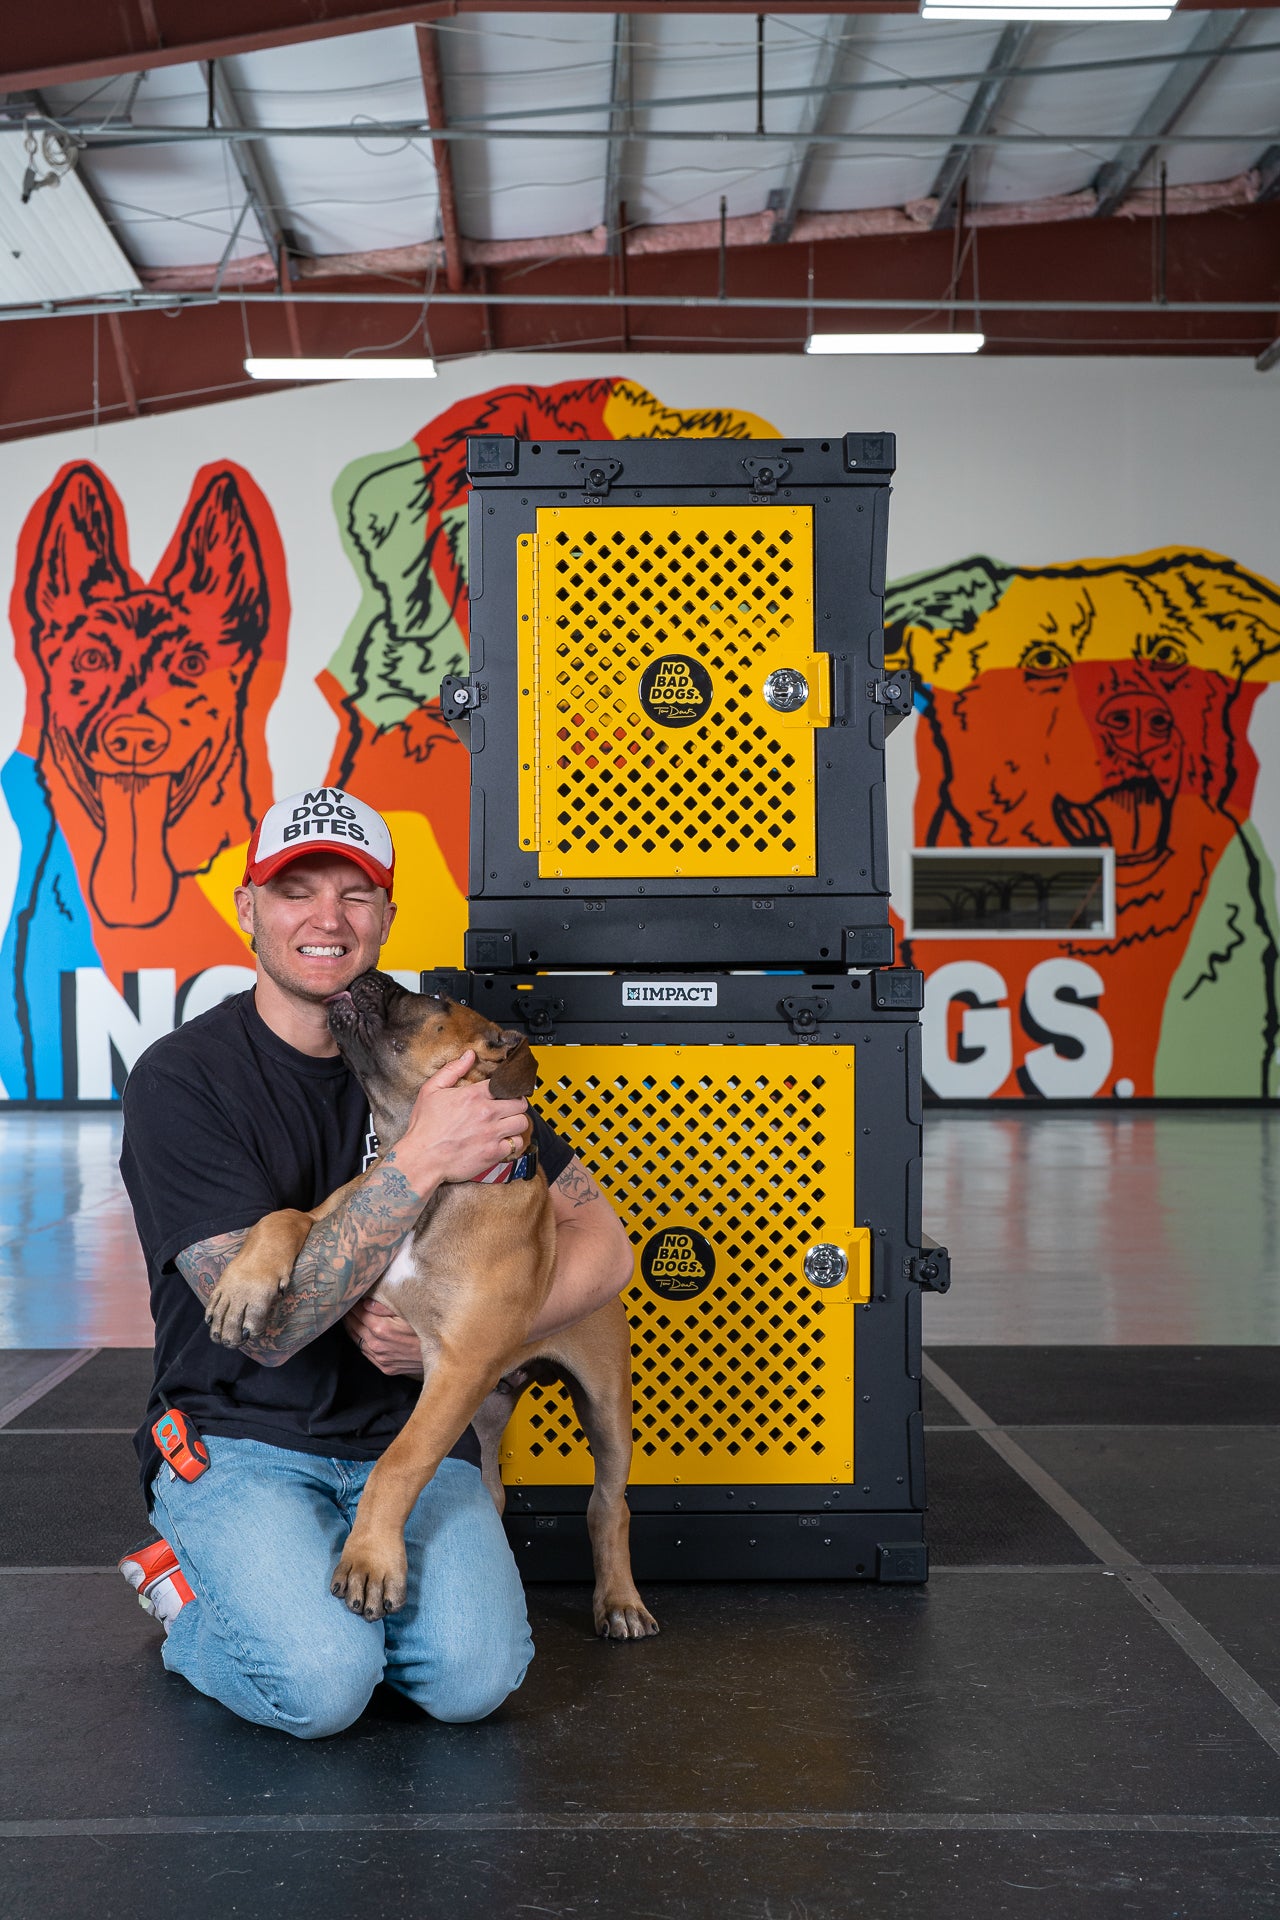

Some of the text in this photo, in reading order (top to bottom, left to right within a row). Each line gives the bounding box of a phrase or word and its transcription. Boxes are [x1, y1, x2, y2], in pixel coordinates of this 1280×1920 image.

[661, 663, 686, 675] NO
[656, 676, 689, 688] BAD
[651, 688, 699, 700] DOGS.
[302, 788, 344, 805] MY
[292, 802, 357, 822] DOG
[283, 818, 370, 846] BITES.
[642, 987, 713, 1001] IMPACT
[664, 1235, 689, 1248] NO
[659, 1248, 692, 1260] BAD
[653, 1260, 701, 1273] DOGS.
